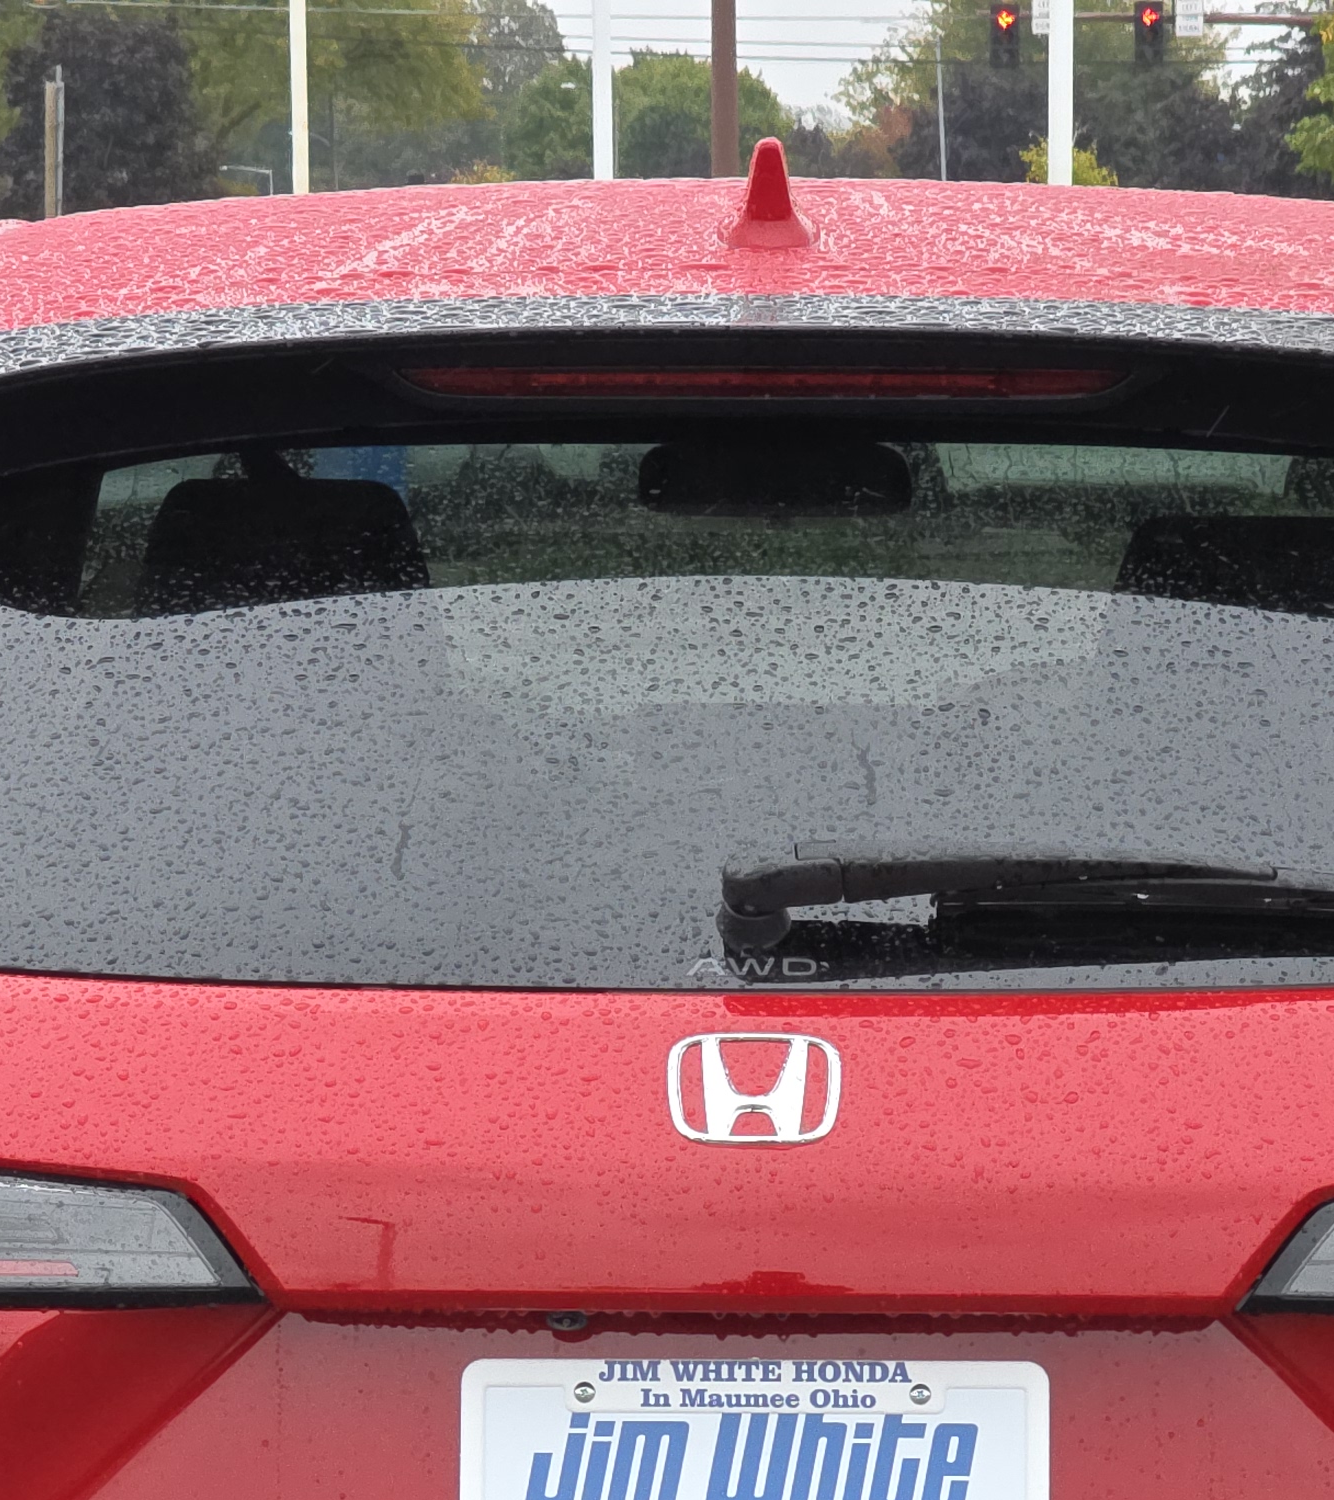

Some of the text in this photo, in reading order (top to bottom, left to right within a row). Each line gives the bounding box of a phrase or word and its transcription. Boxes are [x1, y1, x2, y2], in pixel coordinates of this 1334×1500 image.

[686, 957, 817, 977] AWD
[598, 1360, 912, 1384] JIM WHITE HONDA
[640, 1388, 877, 1410] In Maumee Ohio
